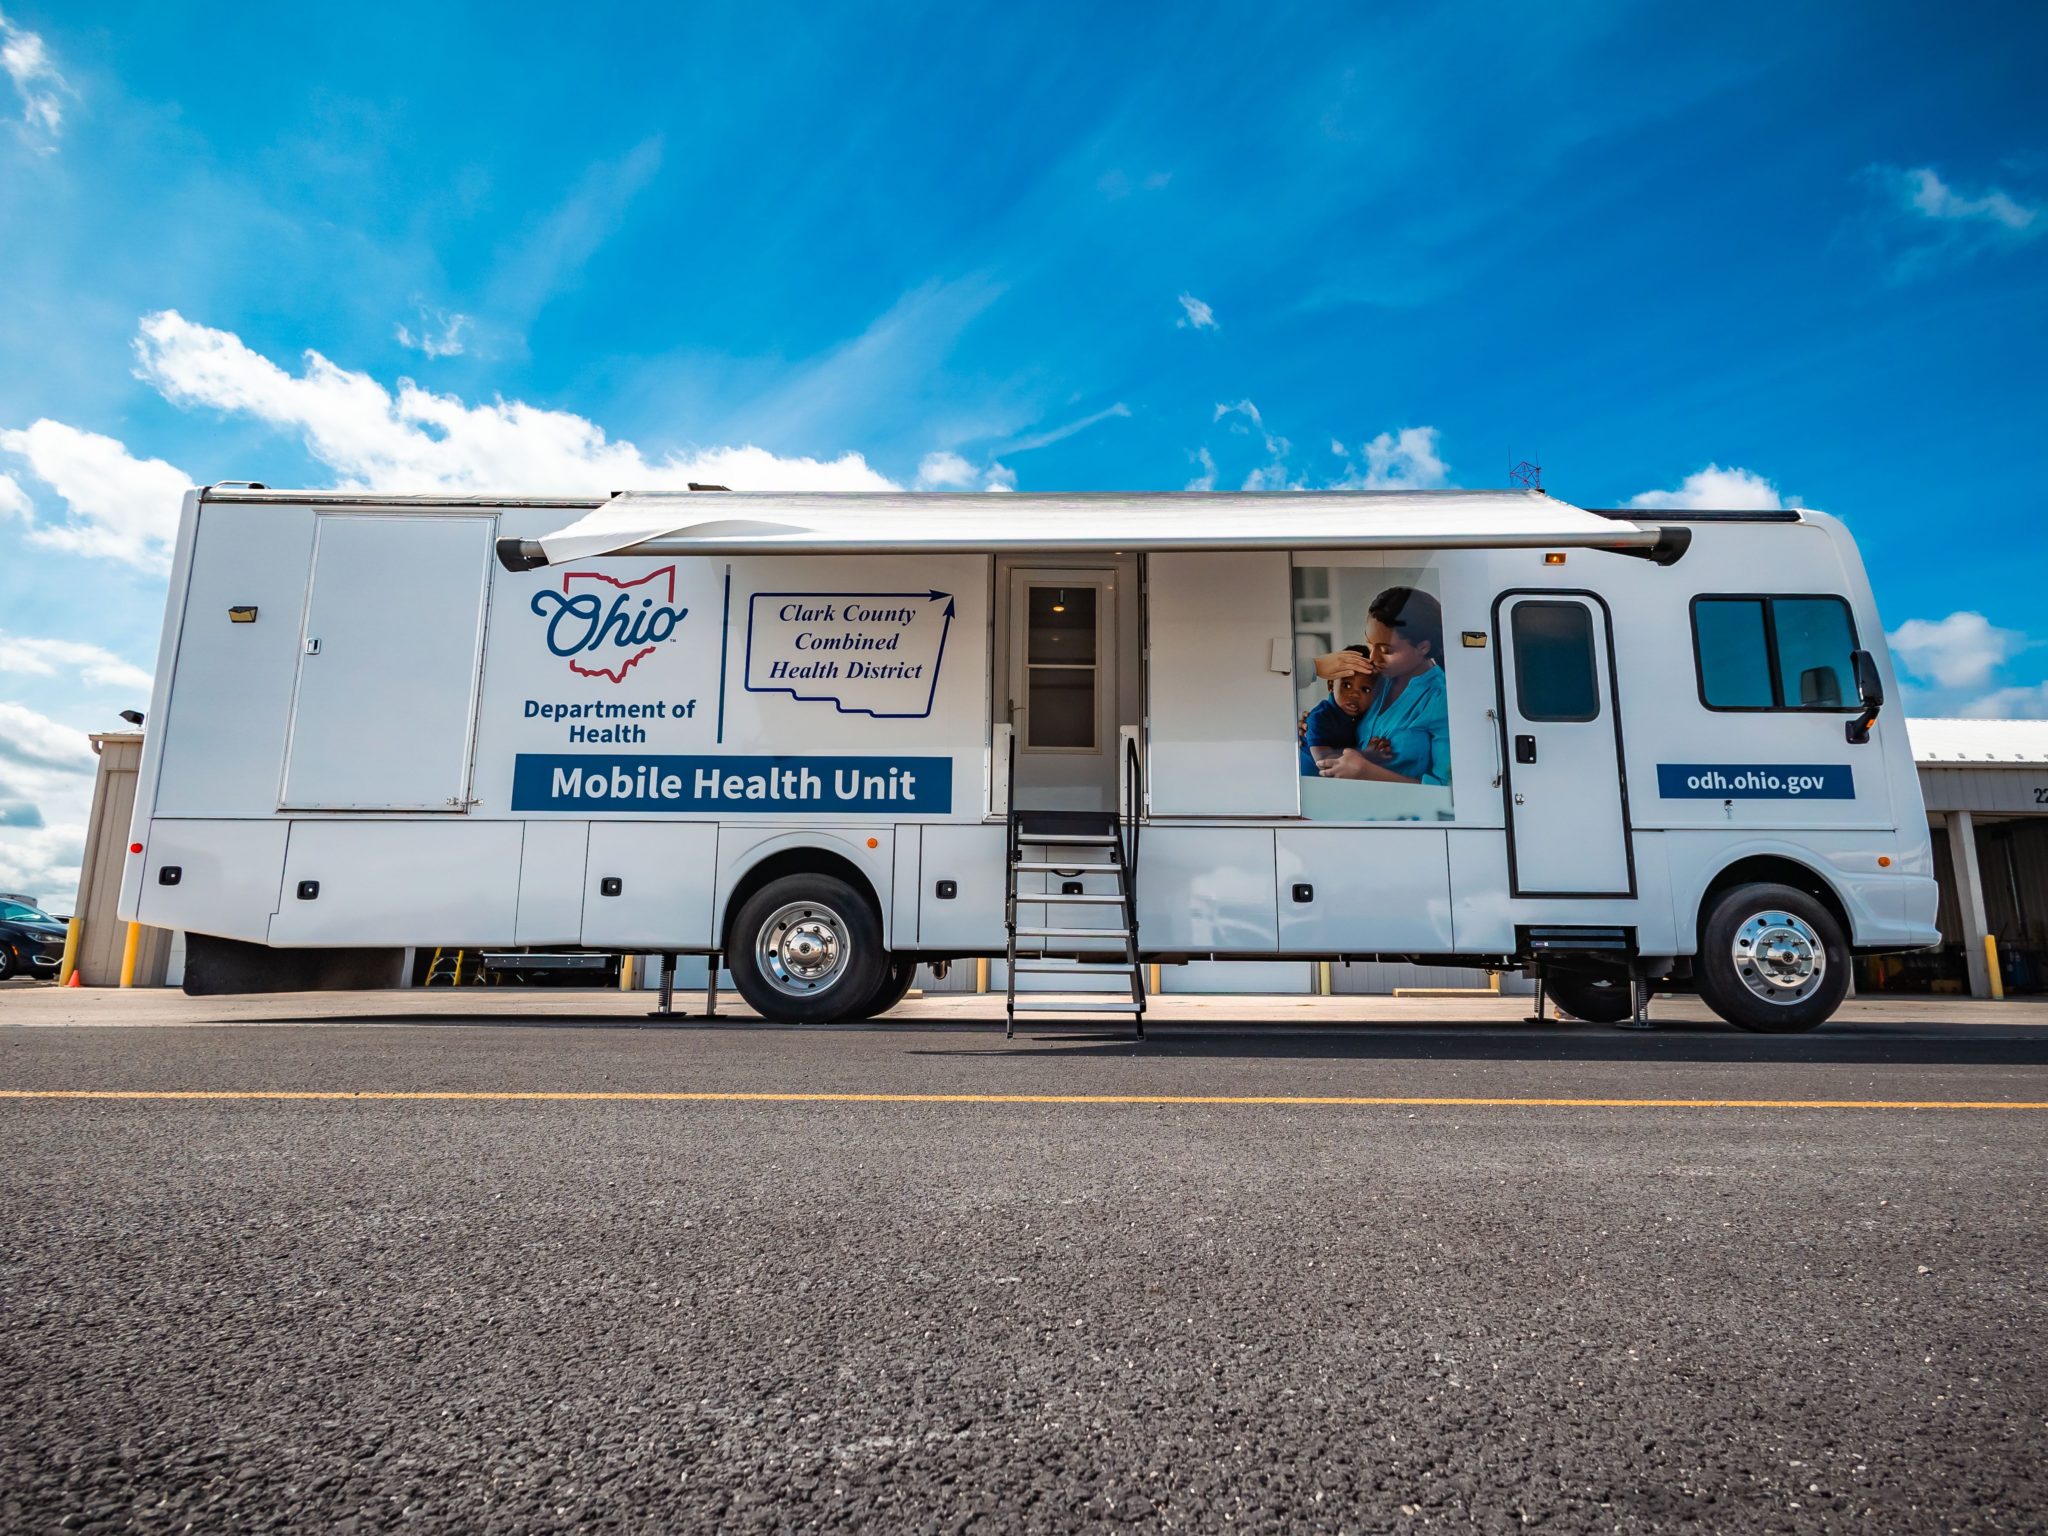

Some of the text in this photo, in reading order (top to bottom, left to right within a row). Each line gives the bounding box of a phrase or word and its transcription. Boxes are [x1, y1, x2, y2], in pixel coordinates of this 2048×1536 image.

[530, 588, 689, 657] Ohio
[779, 604, 916, 626] Clark County
[795, 632, 900, 651] Combined
[769, 661, 923, 679] Health District
[524, 699, 697, 723] Department of
[569, 723, 646, 744] Health
[551, 765, 916, 801] Mobile Health Unit
[1687, 771, 1825, 794] odh.ohio.gov
